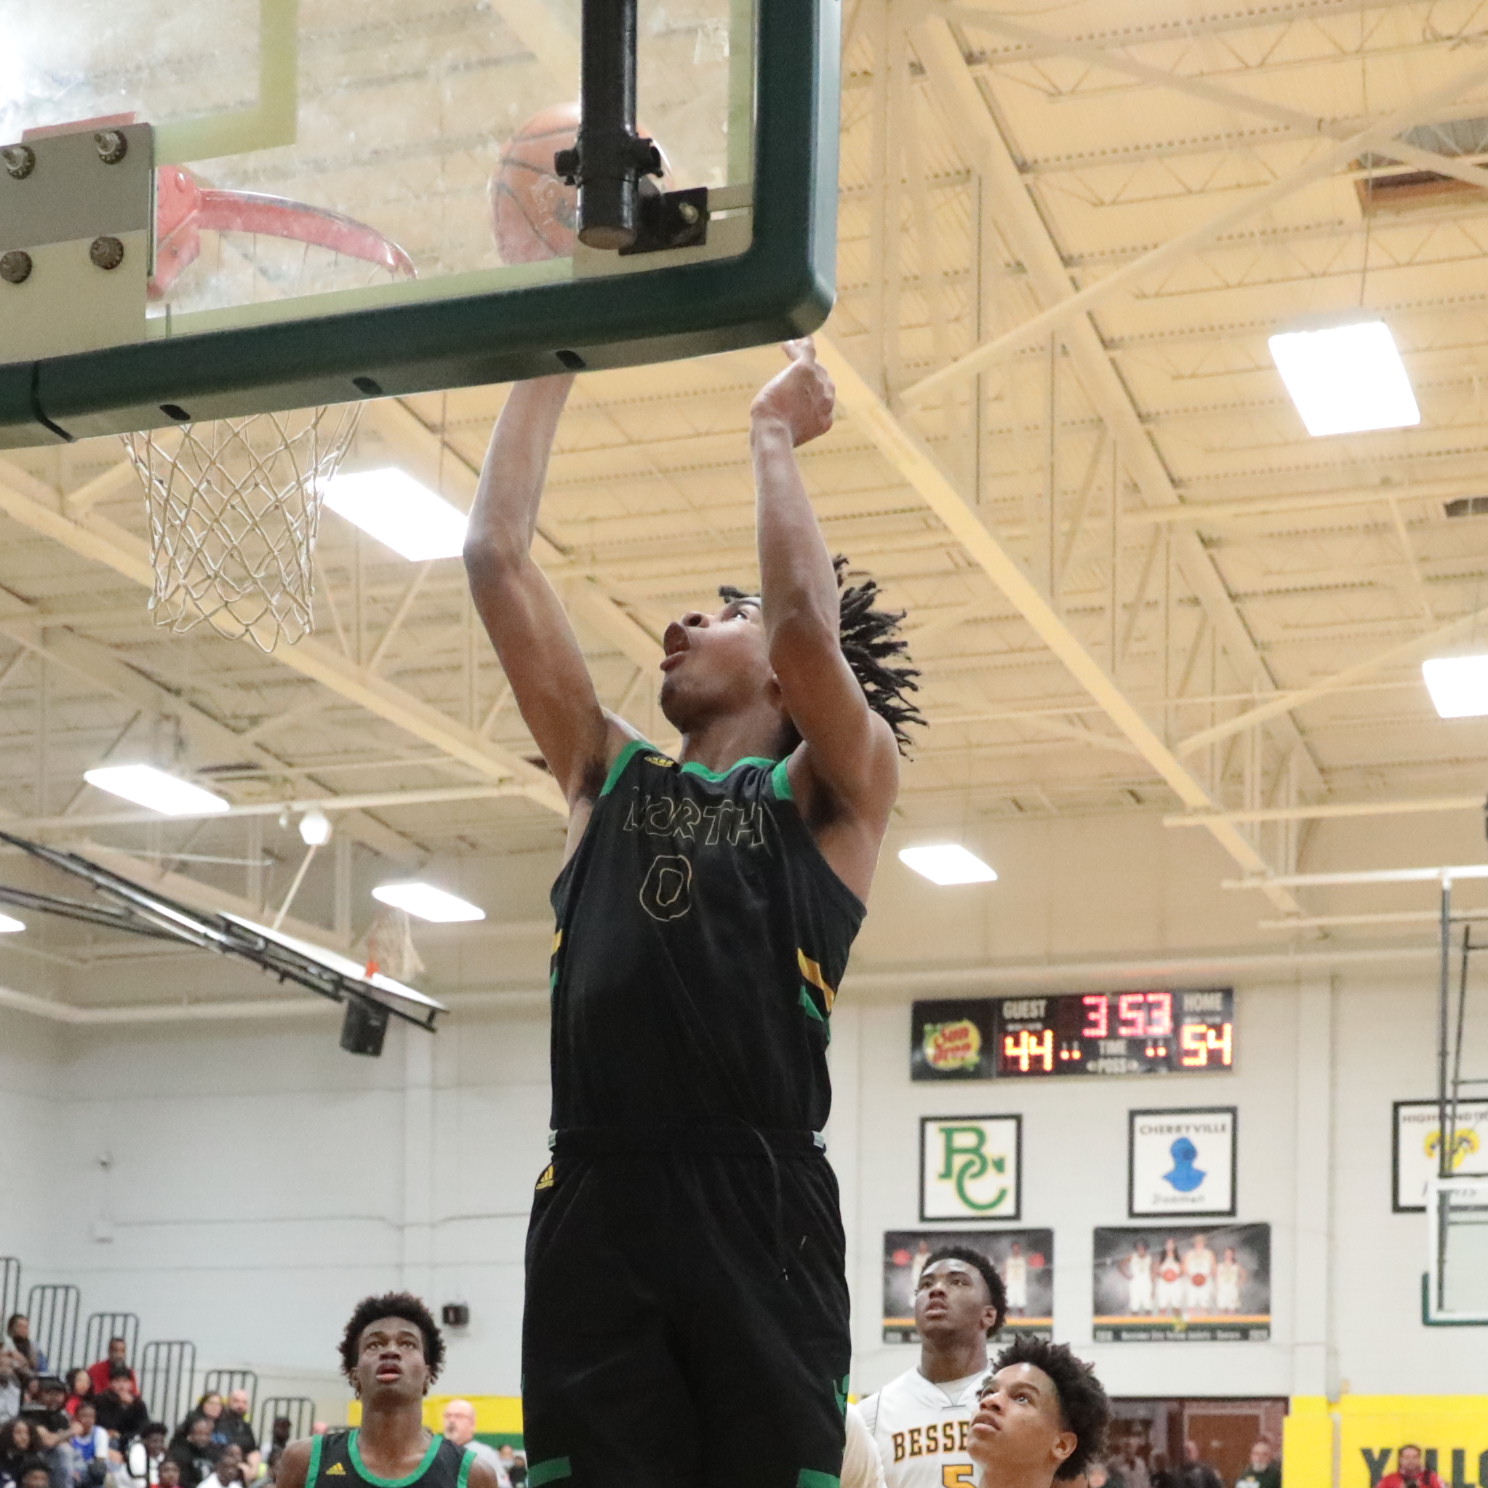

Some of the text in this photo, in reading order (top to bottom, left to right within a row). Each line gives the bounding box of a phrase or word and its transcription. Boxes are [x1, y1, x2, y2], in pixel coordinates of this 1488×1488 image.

[623, 789, 765, 847] NORTH
[639, 855, 693, 922] 0
[1002, 999, 1047, 1019] GUEST
[1183, 992, 1223, 1011] HOME
[1004, 1022, 1233, 1072] 44 54
[1138, 1123, 1228, 1136] CHERRYVILLE
